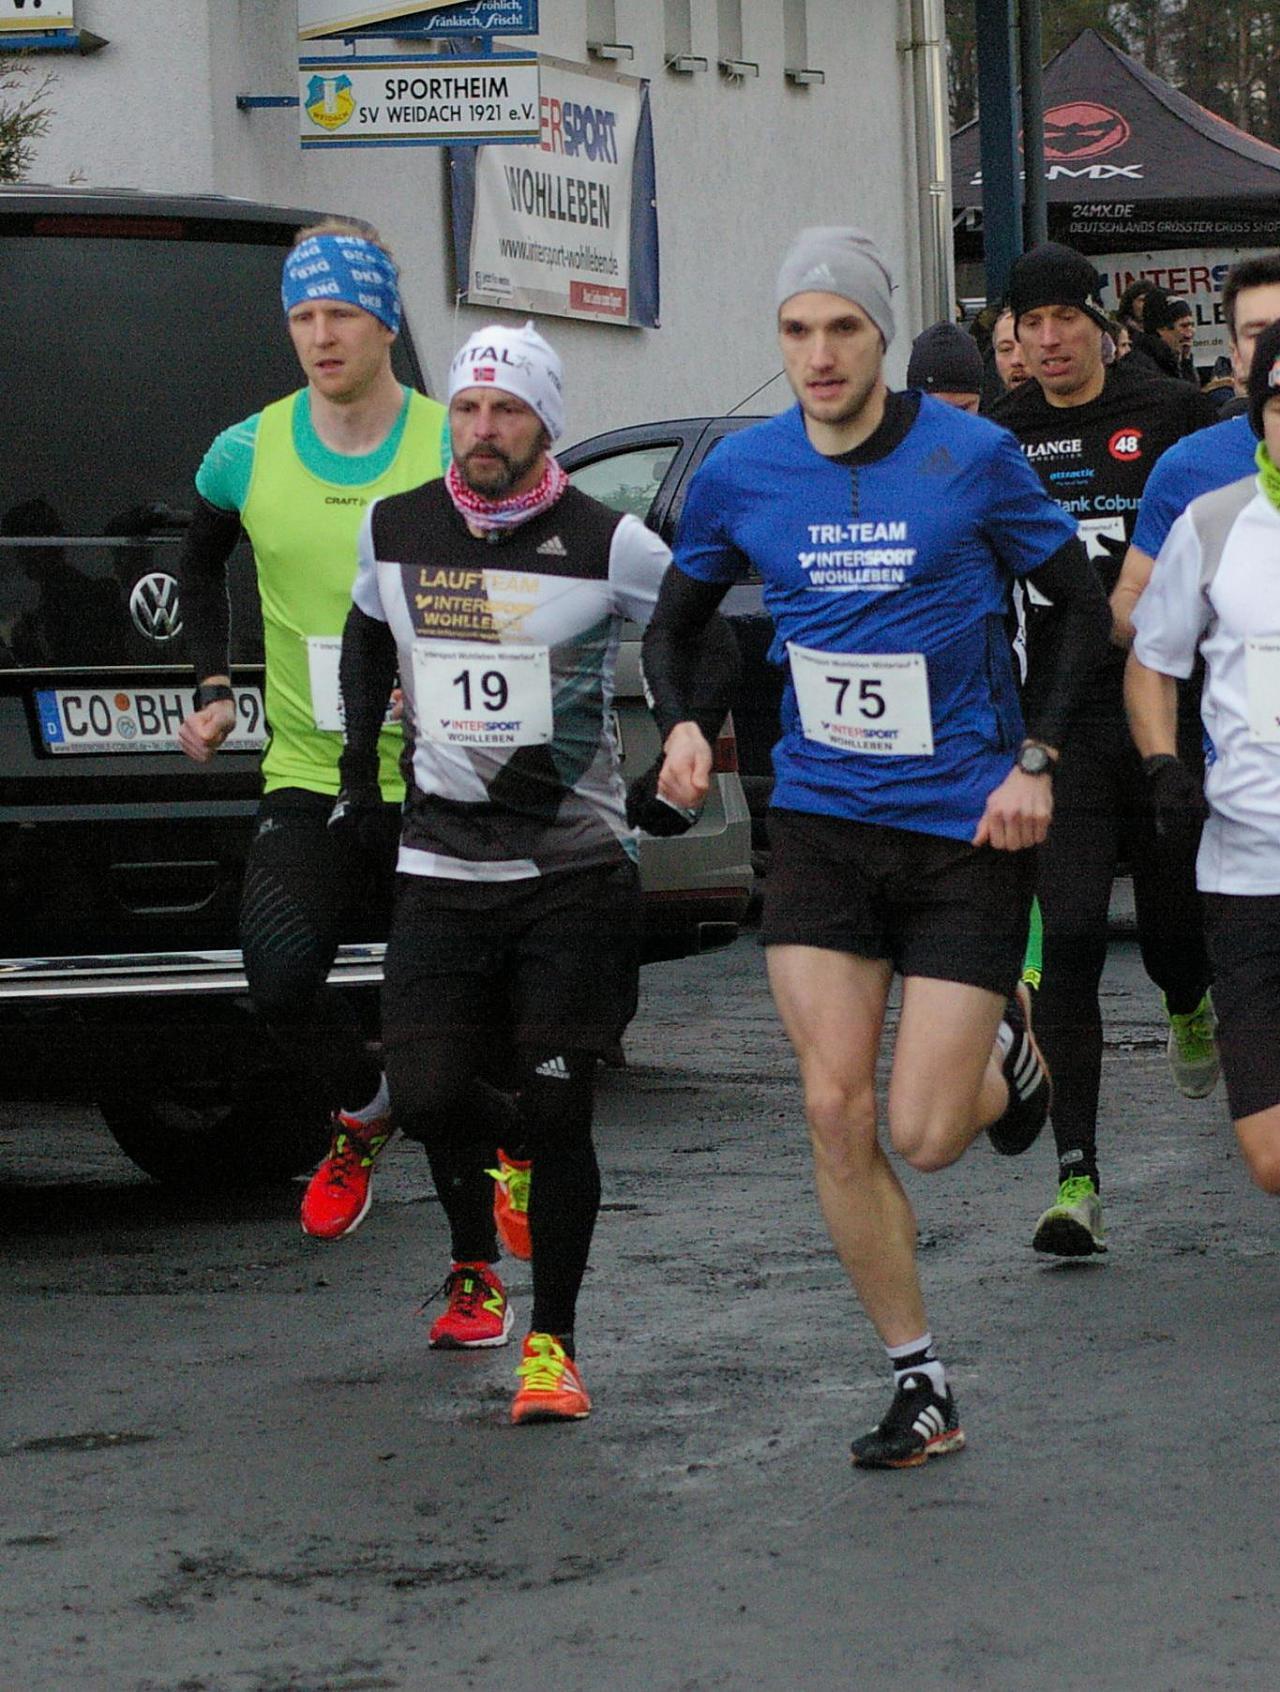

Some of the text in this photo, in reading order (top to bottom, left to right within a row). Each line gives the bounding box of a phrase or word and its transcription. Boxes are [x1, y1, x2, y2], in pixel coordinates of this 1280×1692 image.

[423, 13, 523, 30] fränkisch, frisch!
[385, 77, 509, 100] SPORTHEIM
[359, 103, 536, 123] SV WEIDACH 1921 e.V.
[503, 165, 611, 229] WOHLLEBEN
[1072, 205, 1134, 218] 24MX.DE
[1070, 222, 1155, 233] DEUTSCHLANDS
[1114, 264, 1229, 298] INTERS
[1027, 439, 1083, 457] LANGE
[1115, 436, 1138, 453] 48
[325, 496, 359, 505] CRAFT
[808, 522, 907, 544] TRI-TEAM
[817, 549, 917, 567] INTERSPORT
[810, 569, 904, 584] WOHLLEBEN
[453, 670, 509, 711] 19
[825, 677, 886, 719] 75
[62, 690, 112, 737] CO
[136, 693, 188, 735] BH
[237, 693, 261, 734] 9
[452, 720, 522, 731] INTERSPORT
[832, 724, 899, 739] INTERSPORT
[448, 732, 515, 743] WOHLLEBEN
[830, 735, 893, 750] WOHLLEBEN
